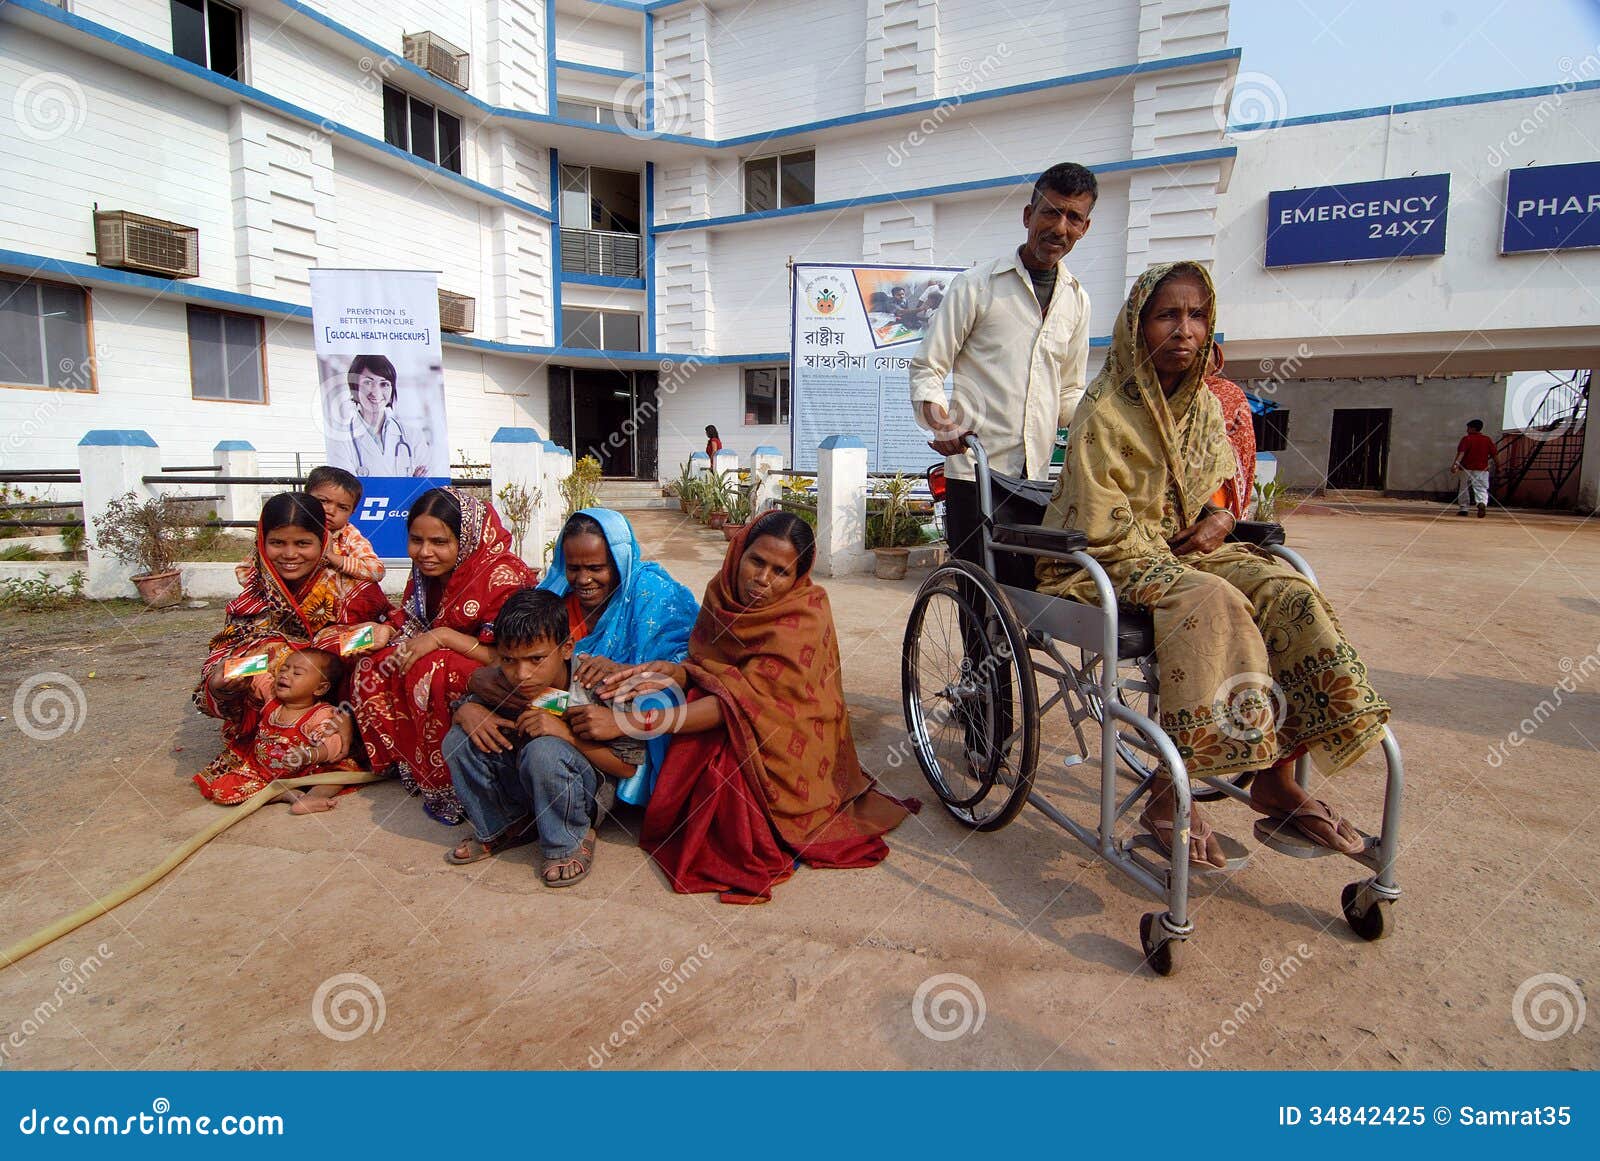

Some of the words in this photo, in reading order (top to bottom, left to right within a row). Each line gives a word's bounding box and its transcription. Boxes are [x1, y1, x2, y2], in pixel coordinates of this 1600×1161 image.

[1280, 195, 1438, 225] EMERGENCY
[1517, 194, 1600, 218] PHAR
[1368, 219, 1435, 239] 24X7
[346, 307, 395, 316] PREVENTION
[369, 317, 392, 325] THAN
[393, 318, 414, 326] CURE
[361, 331, 388, 340] HEALTH
[803, 326, 845, 346] রাষ্ট্রীয়
[874, 355, 912, 369] যোজ
[388, 510, 409, 518] GLO
